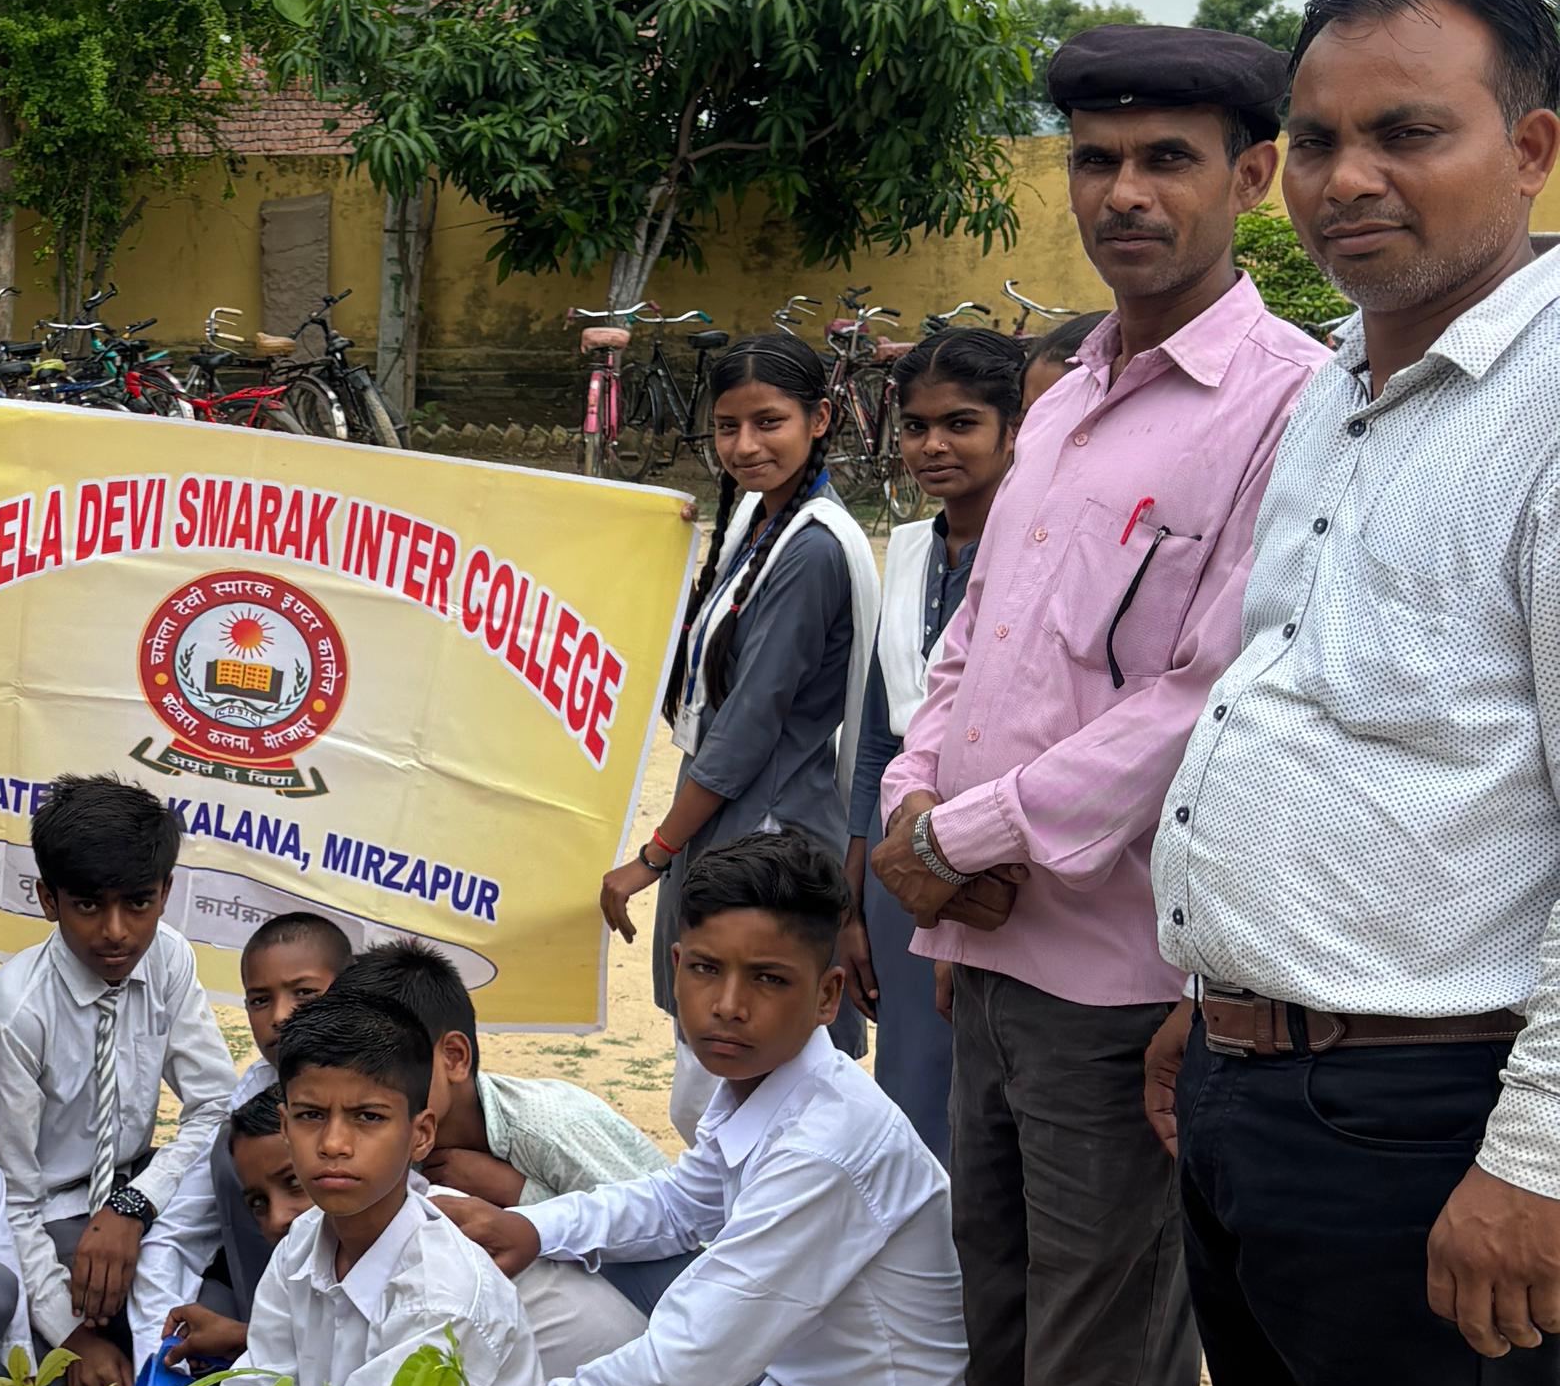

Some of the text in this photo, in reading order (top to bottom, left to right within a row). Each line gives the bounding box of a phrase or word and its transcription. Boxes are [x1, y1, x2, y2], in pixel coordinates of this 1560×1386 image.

[75, 478, 167, 561] DEVI
[174, 476, 339, 567] SMARAK
[341, 501, 458, 616] INTER
[461, 549, 623, 765] COLLEGE
[146, 579, 344, 696] चमेला देवी स्मारक इण्टर कालेज
[206, 728, 256, 755] कलना,
[223, 766, 239, 783] तु
[246, 770, 294, 787] विद्या
[167, 797, 311, 871] KALANA,
[321, 832, 501, 921] MIRZAPUR
